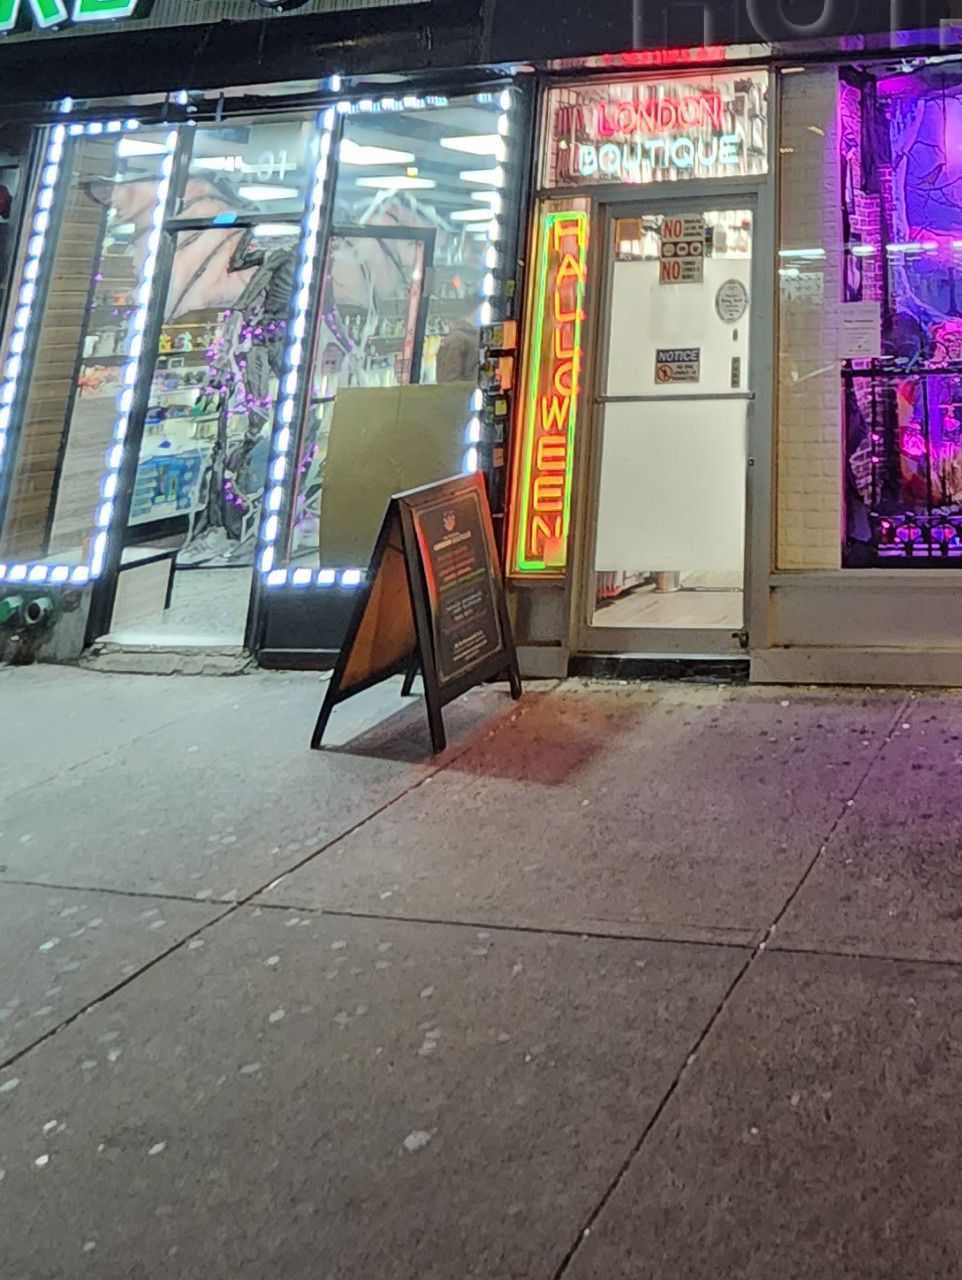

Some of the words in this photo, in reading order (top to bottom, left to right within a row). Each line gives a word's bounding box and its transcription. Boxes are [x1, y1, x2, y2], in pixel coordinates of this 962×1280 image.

[596, 89, 723, 137] LONDON
[577, 133, 740, 176] BOUTIQUE
[663, 219, 682, 239] NO
[661, 261, 681, 280] NO
[658, 350, 698, 362] NOTICE
[531, 216, 586, 556] HALLOWEEN
